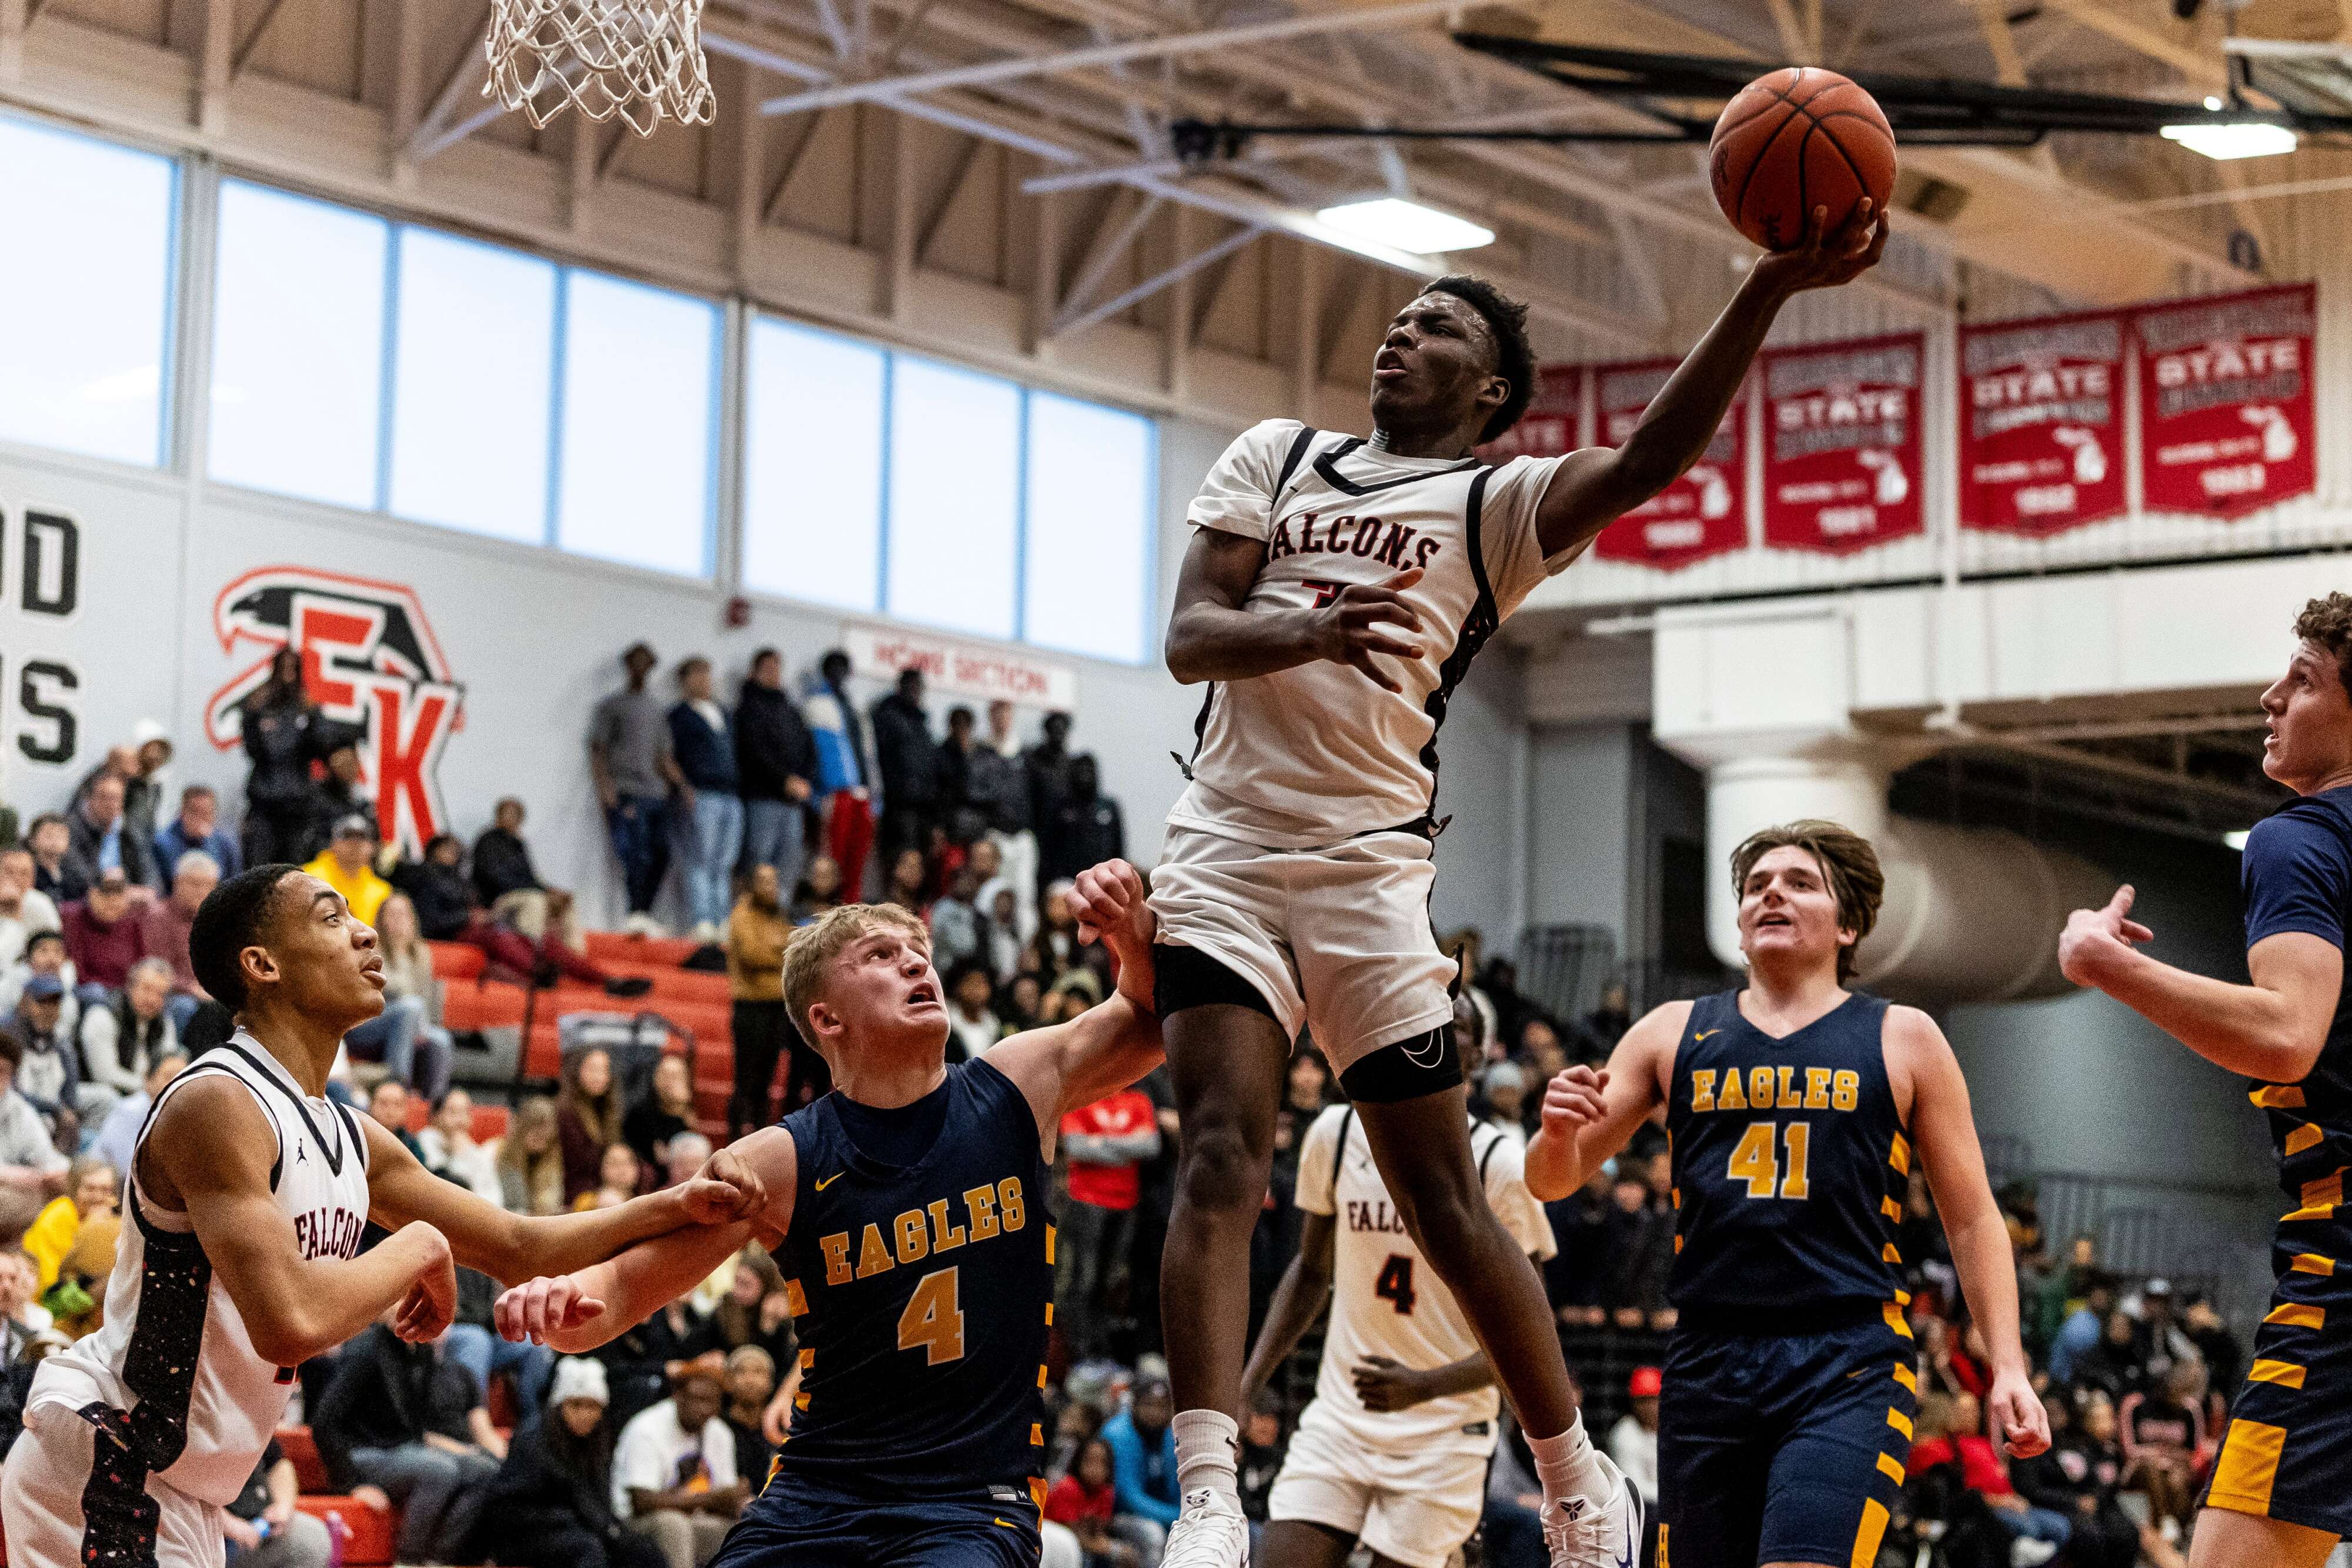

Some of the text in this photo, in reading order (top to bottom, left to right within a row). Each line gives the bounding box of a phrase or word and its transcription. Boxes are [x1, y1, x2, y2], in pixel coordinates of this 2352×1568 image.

[0, 509, 79, 616] D
[1268, 513, 1441, 571] ALCONS
[0, 660, 79, 764] S
[1691, 1066, 1860, 1112] EAGLES
[1727, 1121, 1810, 1201] 41
[820, 1176, 1025, 1286] EAGLES
[897, 1265, 964, 1366] 4
[1375, 1252, 1416, 1316] 4
